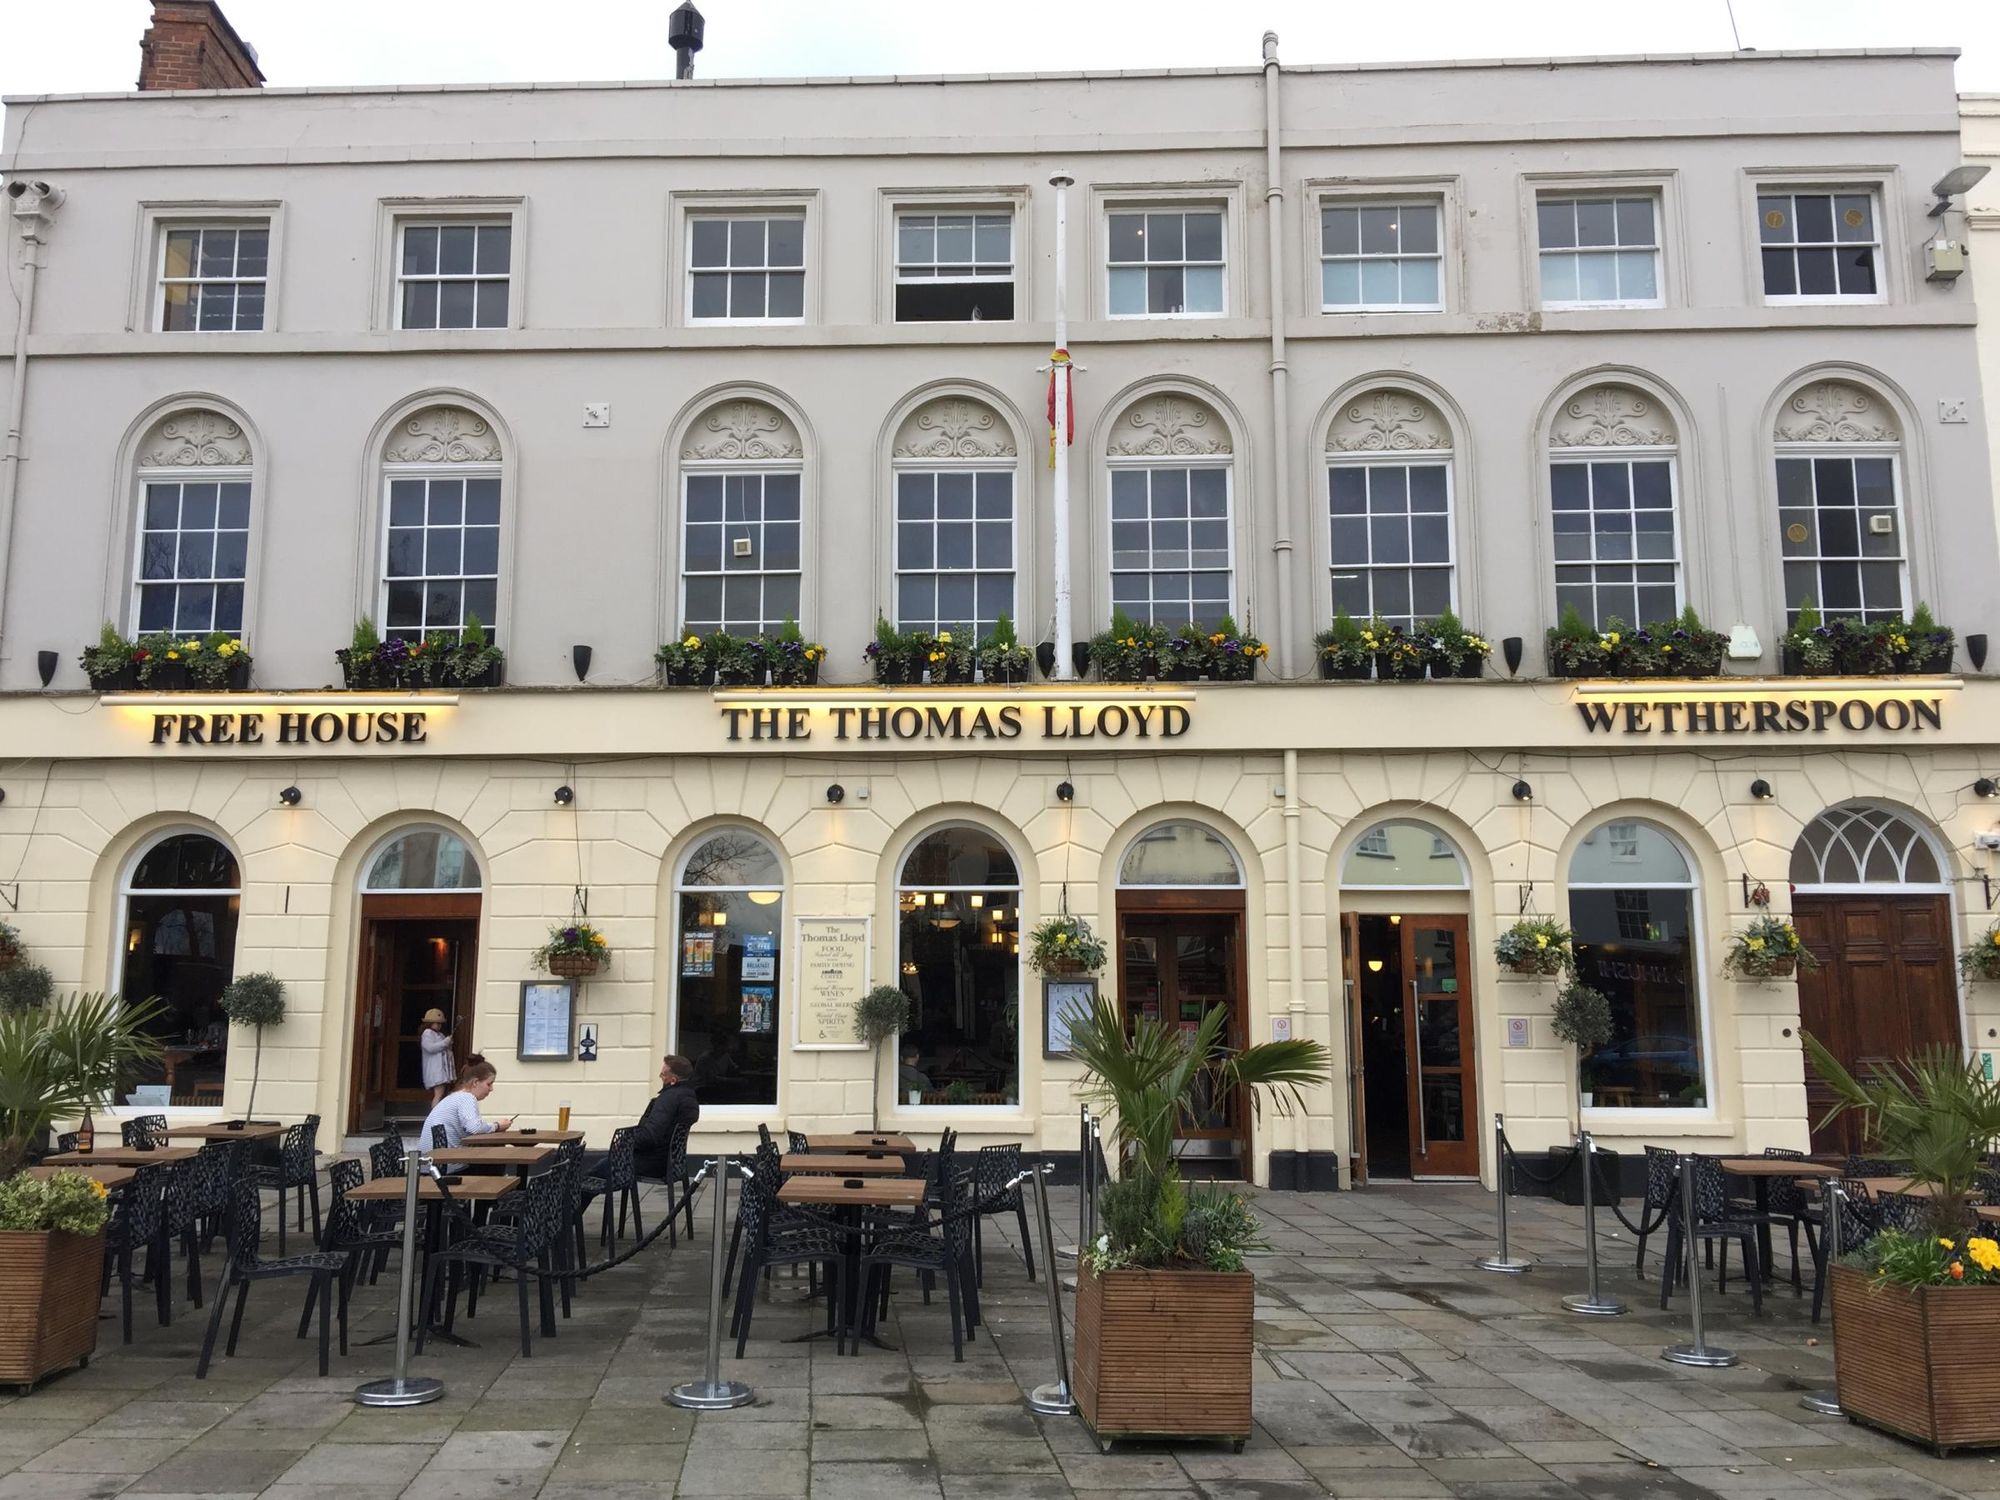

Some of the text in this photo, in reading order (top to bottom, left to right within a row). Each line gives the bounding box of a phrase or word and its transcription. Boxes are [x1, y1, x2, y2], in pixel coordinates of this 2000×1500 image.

[150, 711, 428, 745] FREE HOUSE
[721, 704, 1191, 741] THE THOMAS LLOYD
[1576, 698, 1943, 734] WETHERSPOON
[801, 933, 865, 944] Thomas Lloyd
[825, 926, 840, 934] The
